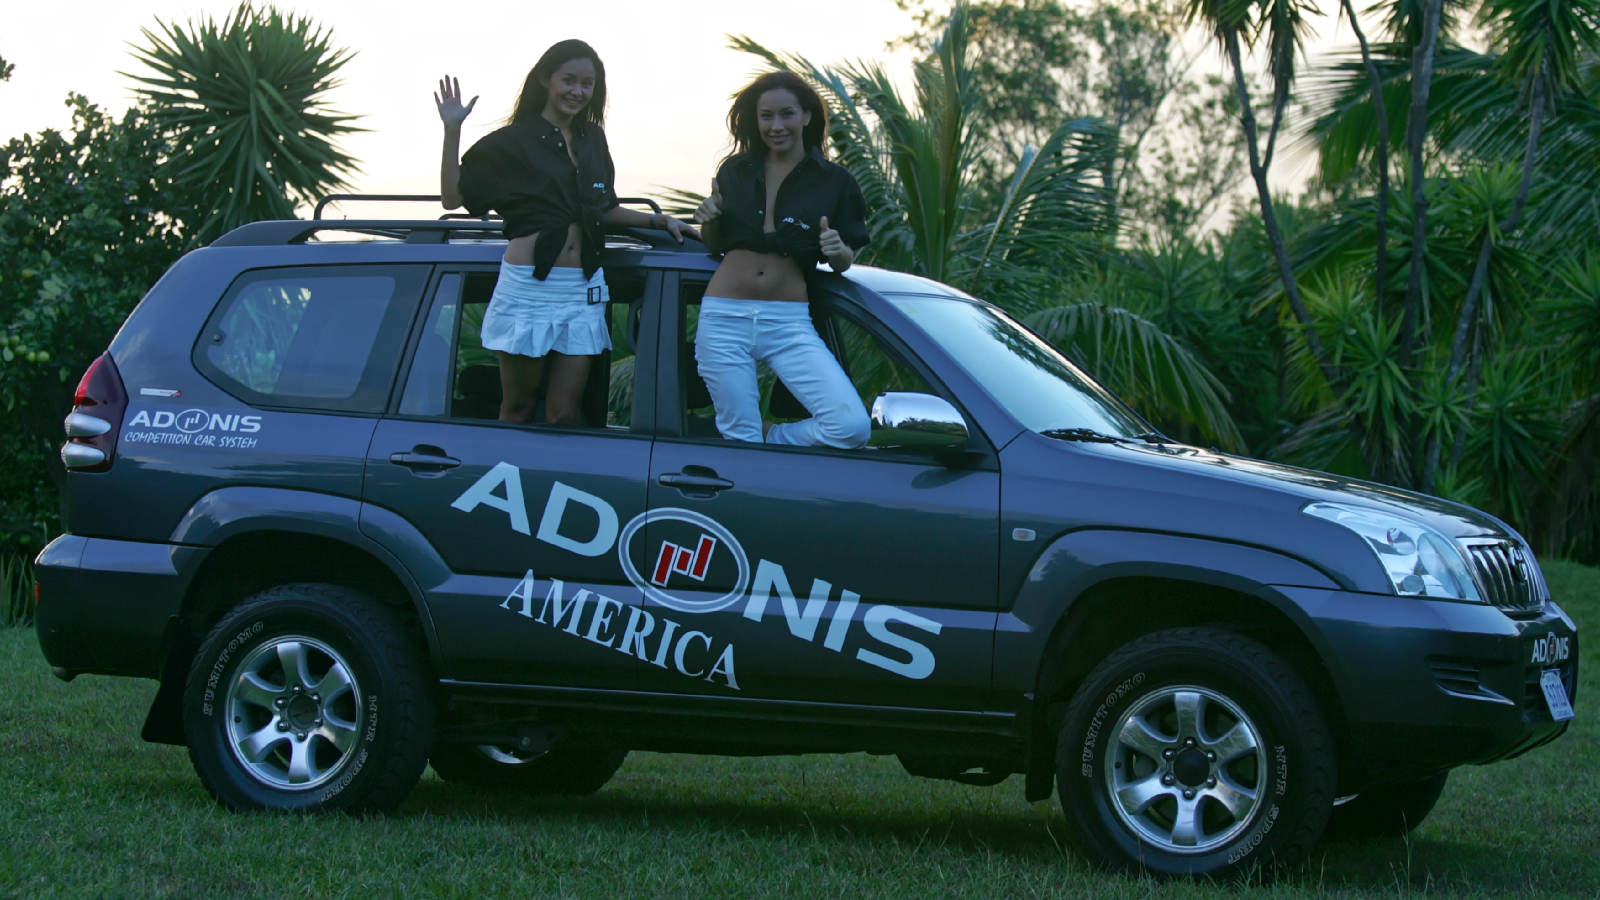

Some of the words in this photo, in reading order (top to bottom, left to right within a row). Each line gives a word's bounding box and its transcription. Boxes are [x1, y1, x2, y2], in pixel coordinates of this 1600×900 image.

[125, 431, 191, 445] COMPETITION
[194, 433, 216, 447] CAR
[219, 435, 257, 448] SYSTEM
[129, 408, 262, 433] ADONIS
[450, 461, 943, 680] ADONIS
[203, 621, 264, 716] SUMITOMO
[499, 569, 741, 690] AMERICA
[1531, 632, 1569, 664] ADONIS
[1082, 672, 1146, 778] SUMITOMO
